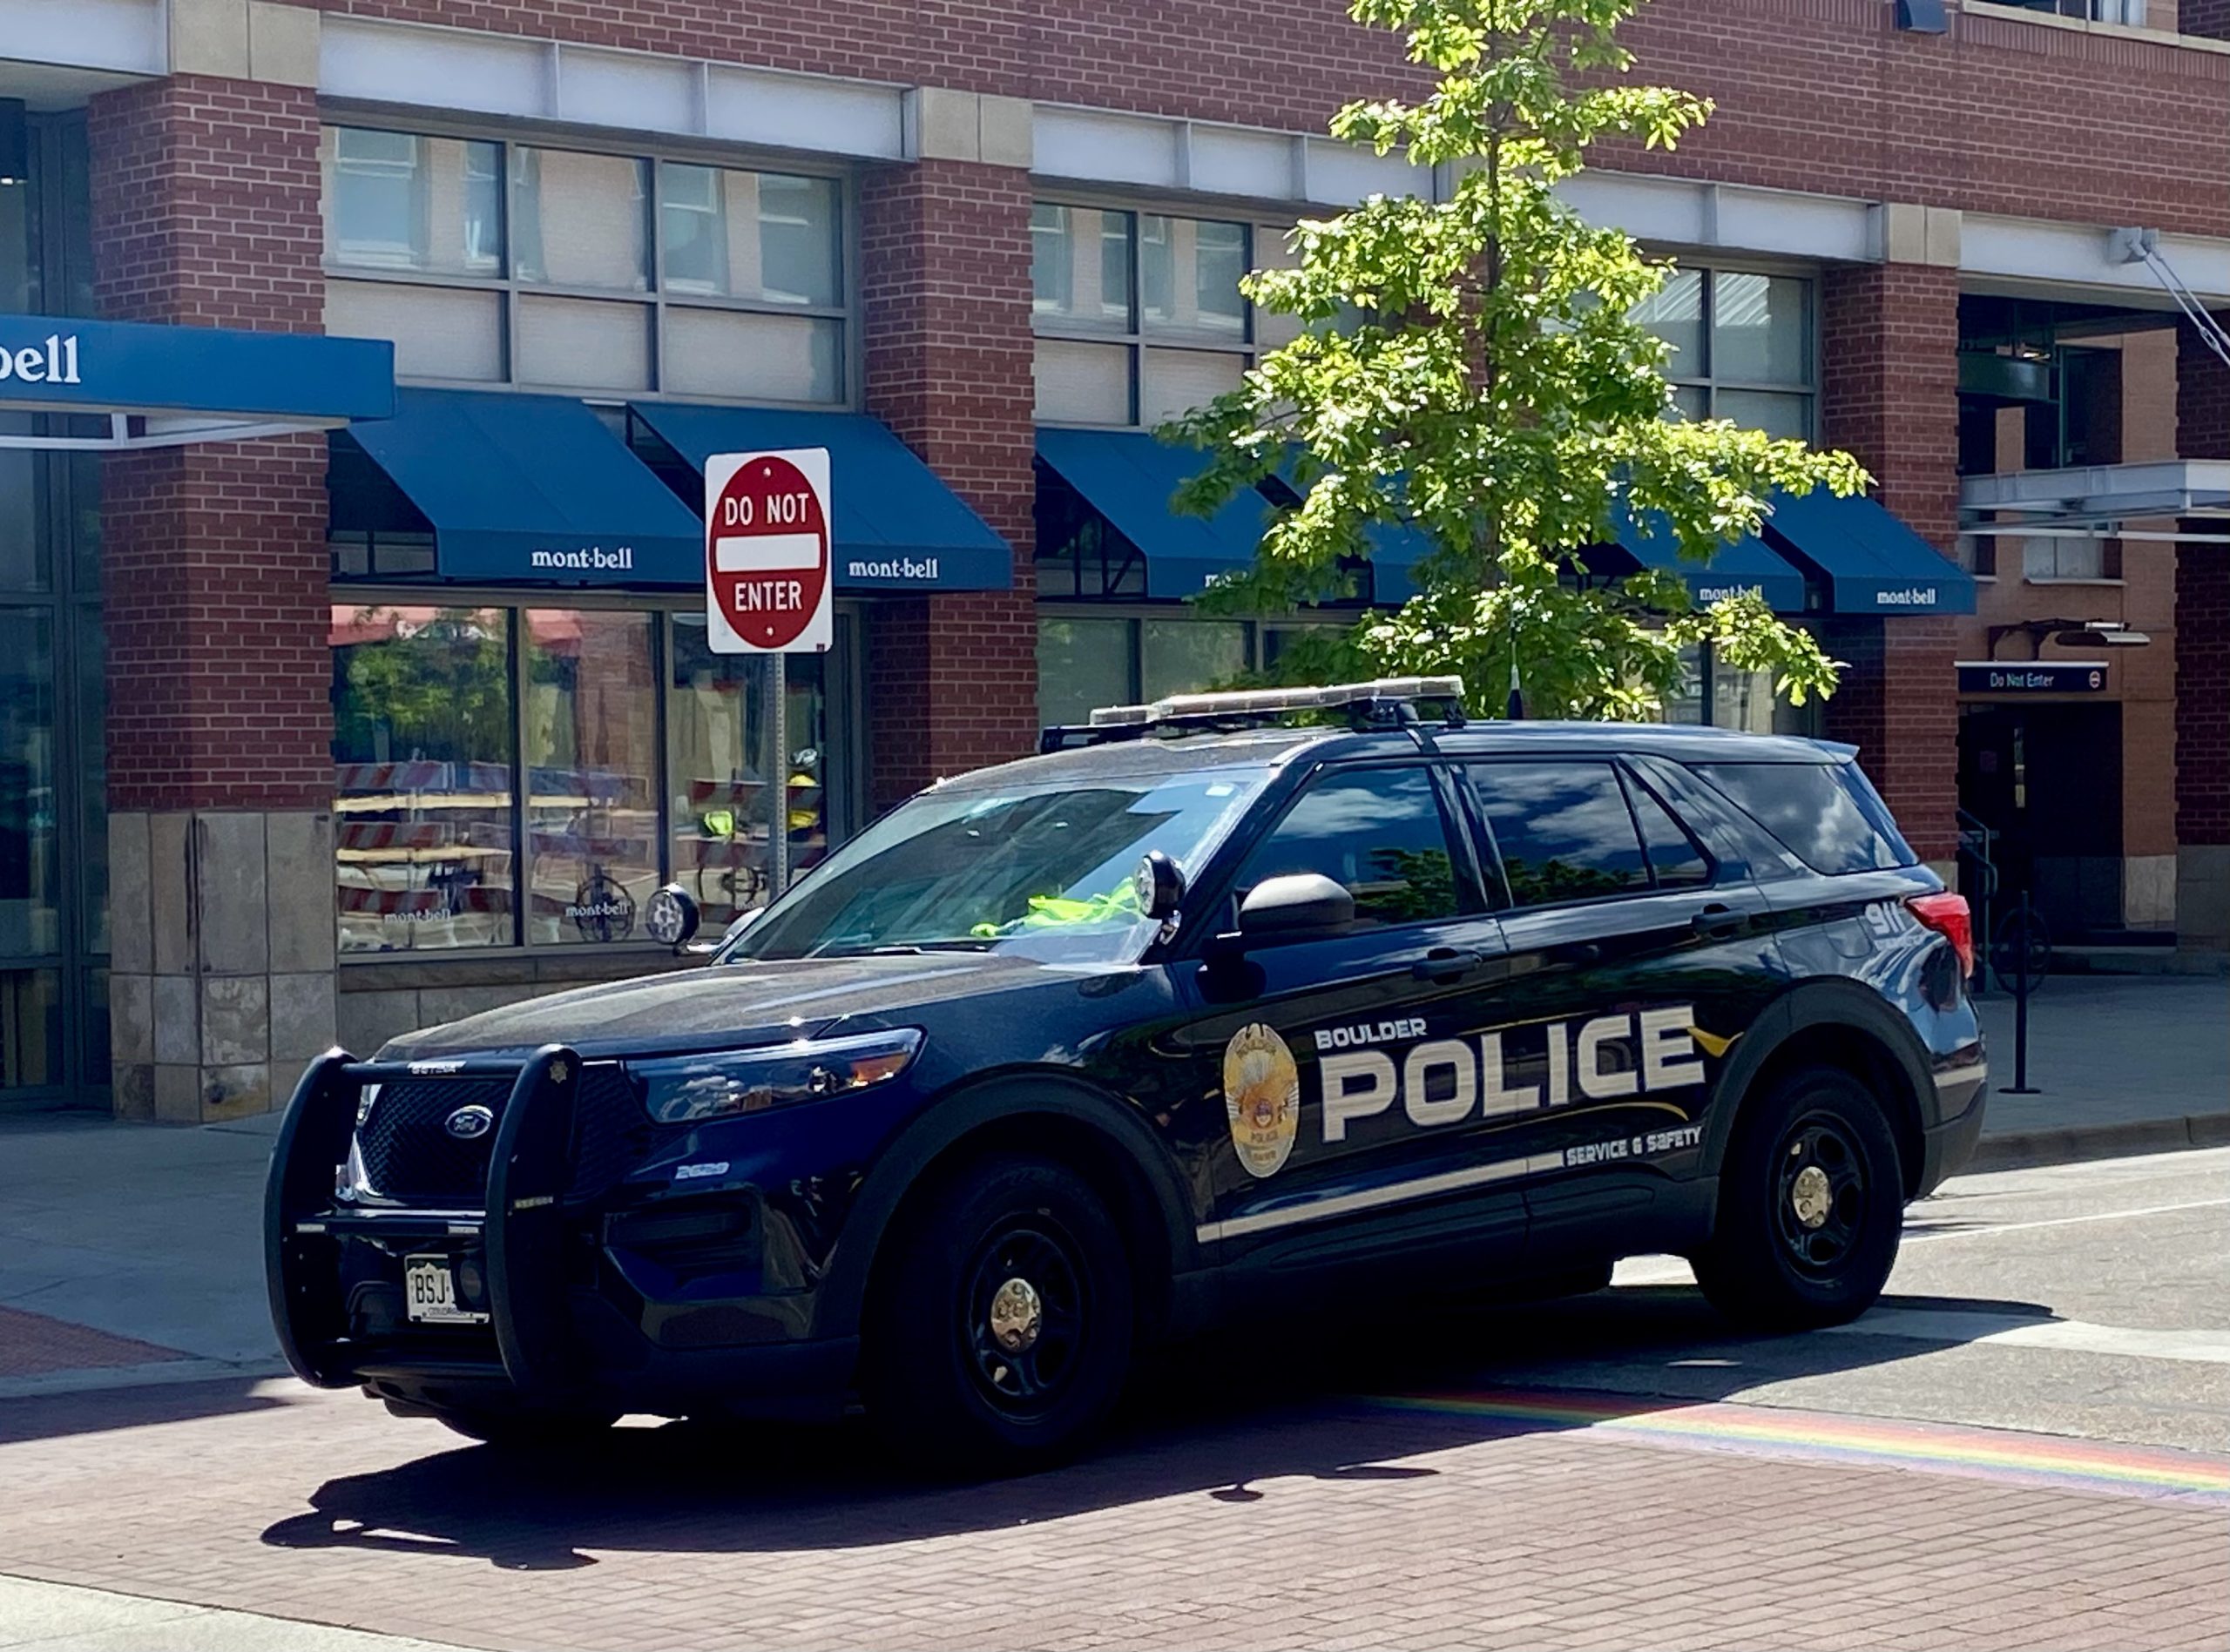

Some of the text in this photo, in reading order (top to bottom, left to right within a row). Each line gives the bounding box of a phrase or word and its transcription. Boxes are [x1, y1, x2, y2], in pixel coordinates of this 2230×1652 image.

[725, 493, 809, 526] DO NOT
[735, 581, 802, 611] ENTER
[1990, 671, 2055, 688] Do Not Enter
[1865, 901, 1907, 935] 911
[1314, 1017, 1429, 1050] BOULDER
[1320, 1004, 1706, 1143] POLICE
[1566, 1139, 1629, 1167] SERVICE
[414, 1273, 446, 1305] BSJ
